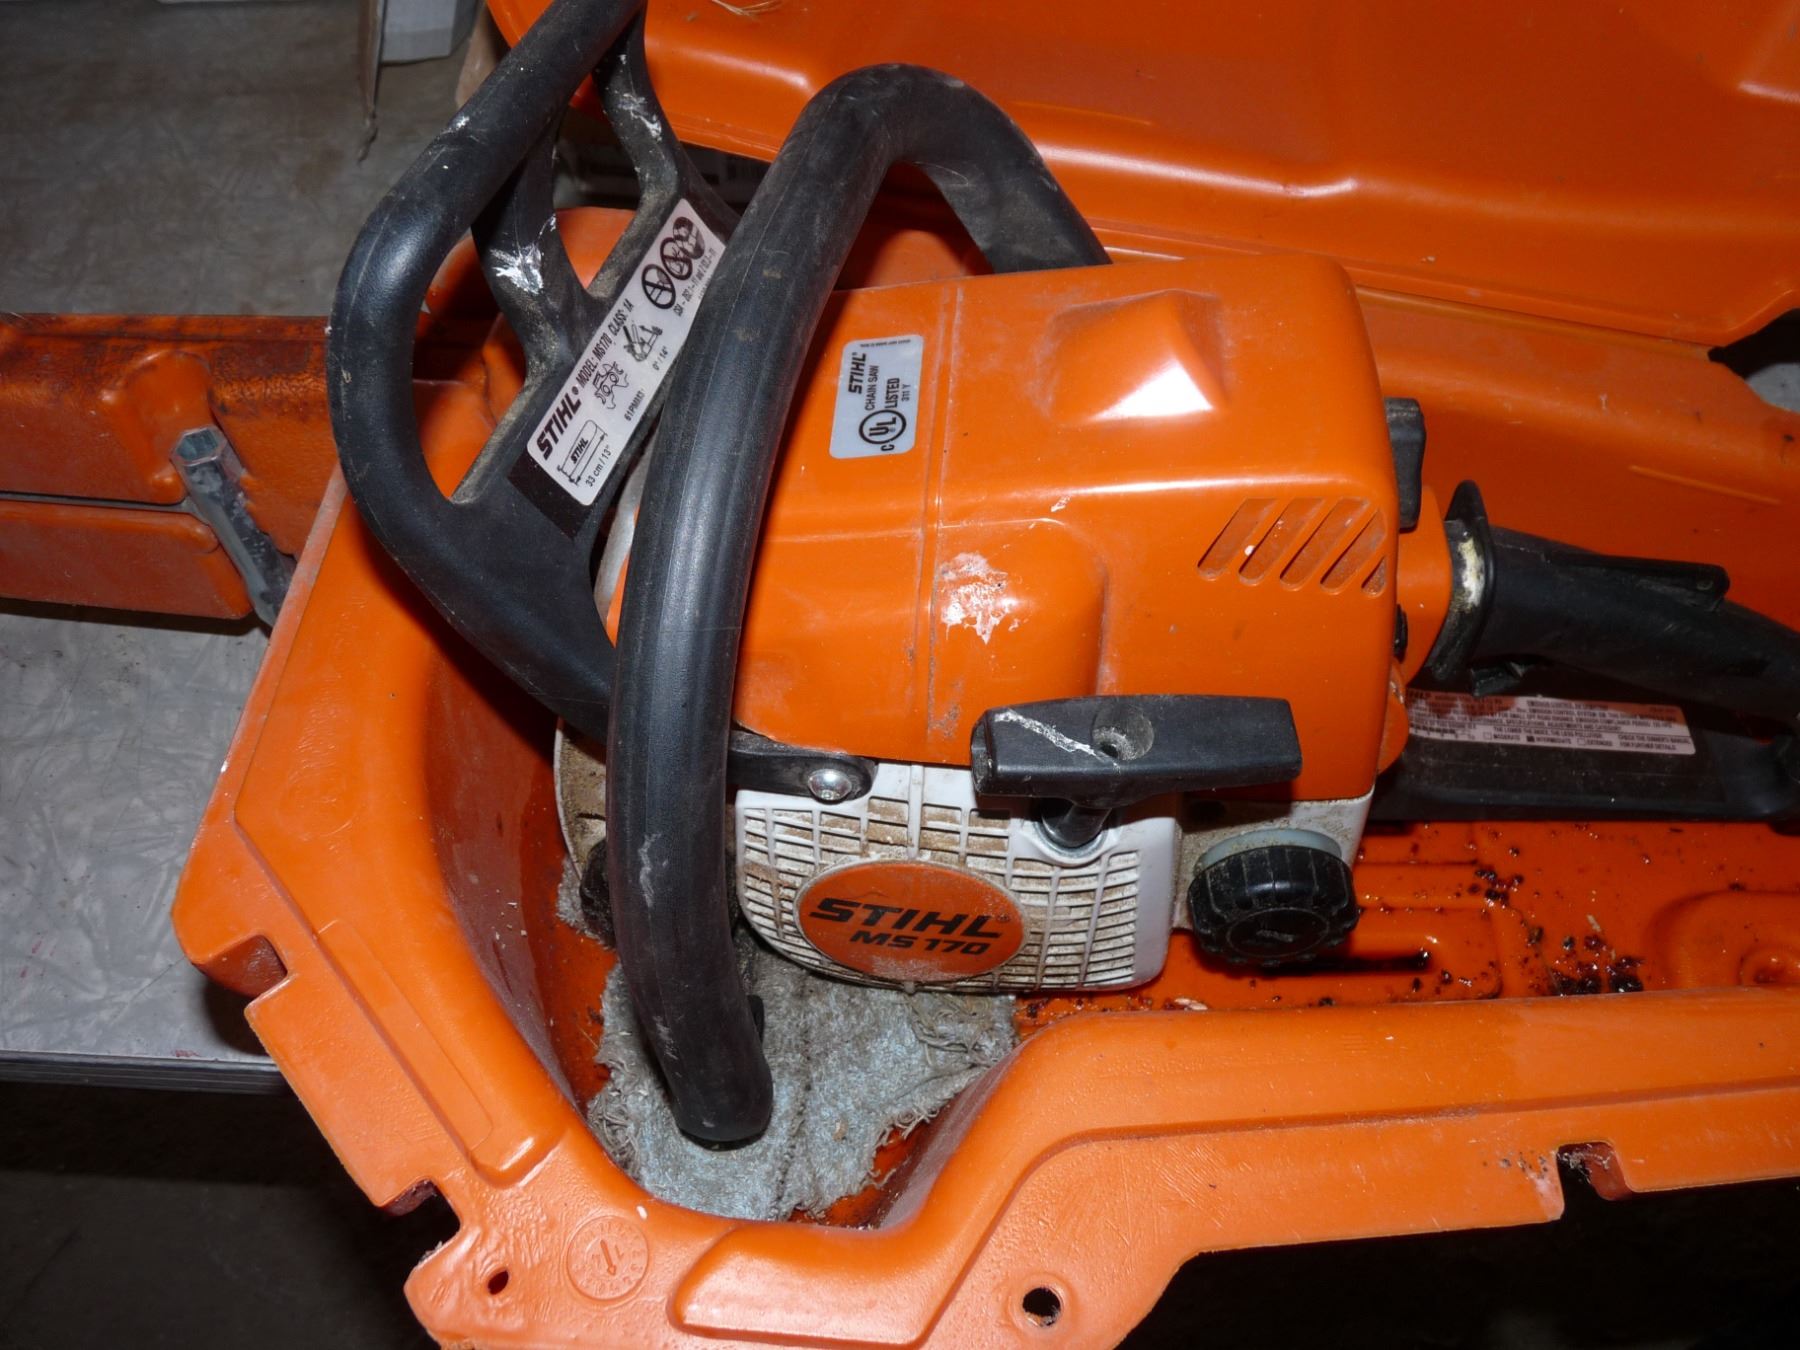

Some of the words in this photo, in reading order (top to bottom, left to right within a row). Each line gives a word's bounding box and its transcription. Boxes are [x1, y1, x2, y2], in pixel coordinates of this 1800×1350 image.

[537, 393, 582, 460] STIHL
[576, 357, 598, 388] MODEL:
[592, 332, 612, 360] MS170
[623, 298, 634, 312] 1A
[848, 352, 866, 394] STIHL
[868, 365, 880, 383] SAW
[865, 384, 877, 410] CHAIN
[884, 378, 900, 408] LISTED
[868, 416, 896, 436] UL
[570, 438, 588, 464] STIHL
[586, 476, 594, 487] 33
[593, 464, 604, 476] cm
[809, 897, 1002, 939] STIHL
[850, 930, 916, 950] MS
[923, 938, 992, 956] 170
